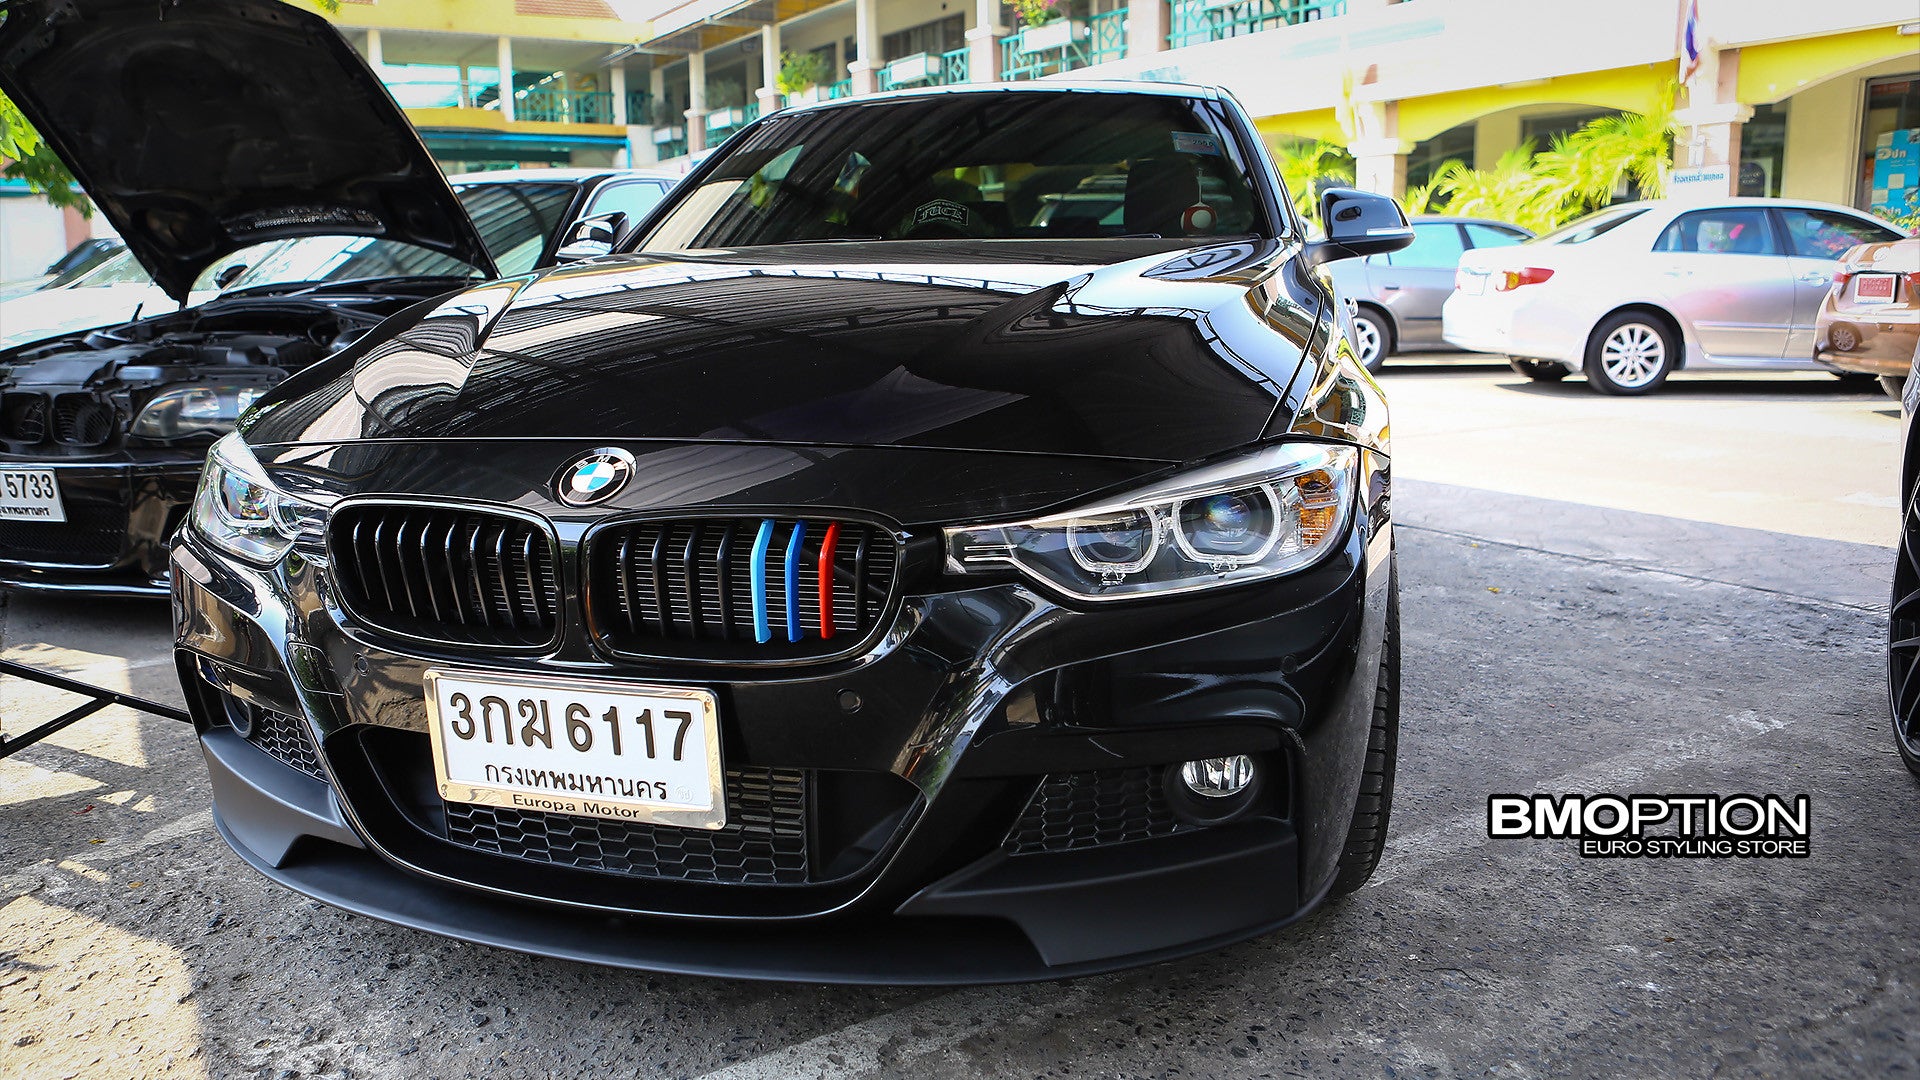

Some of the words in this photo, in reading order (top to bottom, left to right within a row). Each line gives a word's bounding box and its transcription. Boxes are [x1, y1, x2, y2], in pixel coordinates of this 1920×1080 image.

[4, 473, 55, 499] 5733
[564, 702, 693, 762] 6117
[484, 763, 668, 801] กรงเทพมหานคร
[512, 793, 577, 814] Europa
[583, 802, 640, 819] Motor
